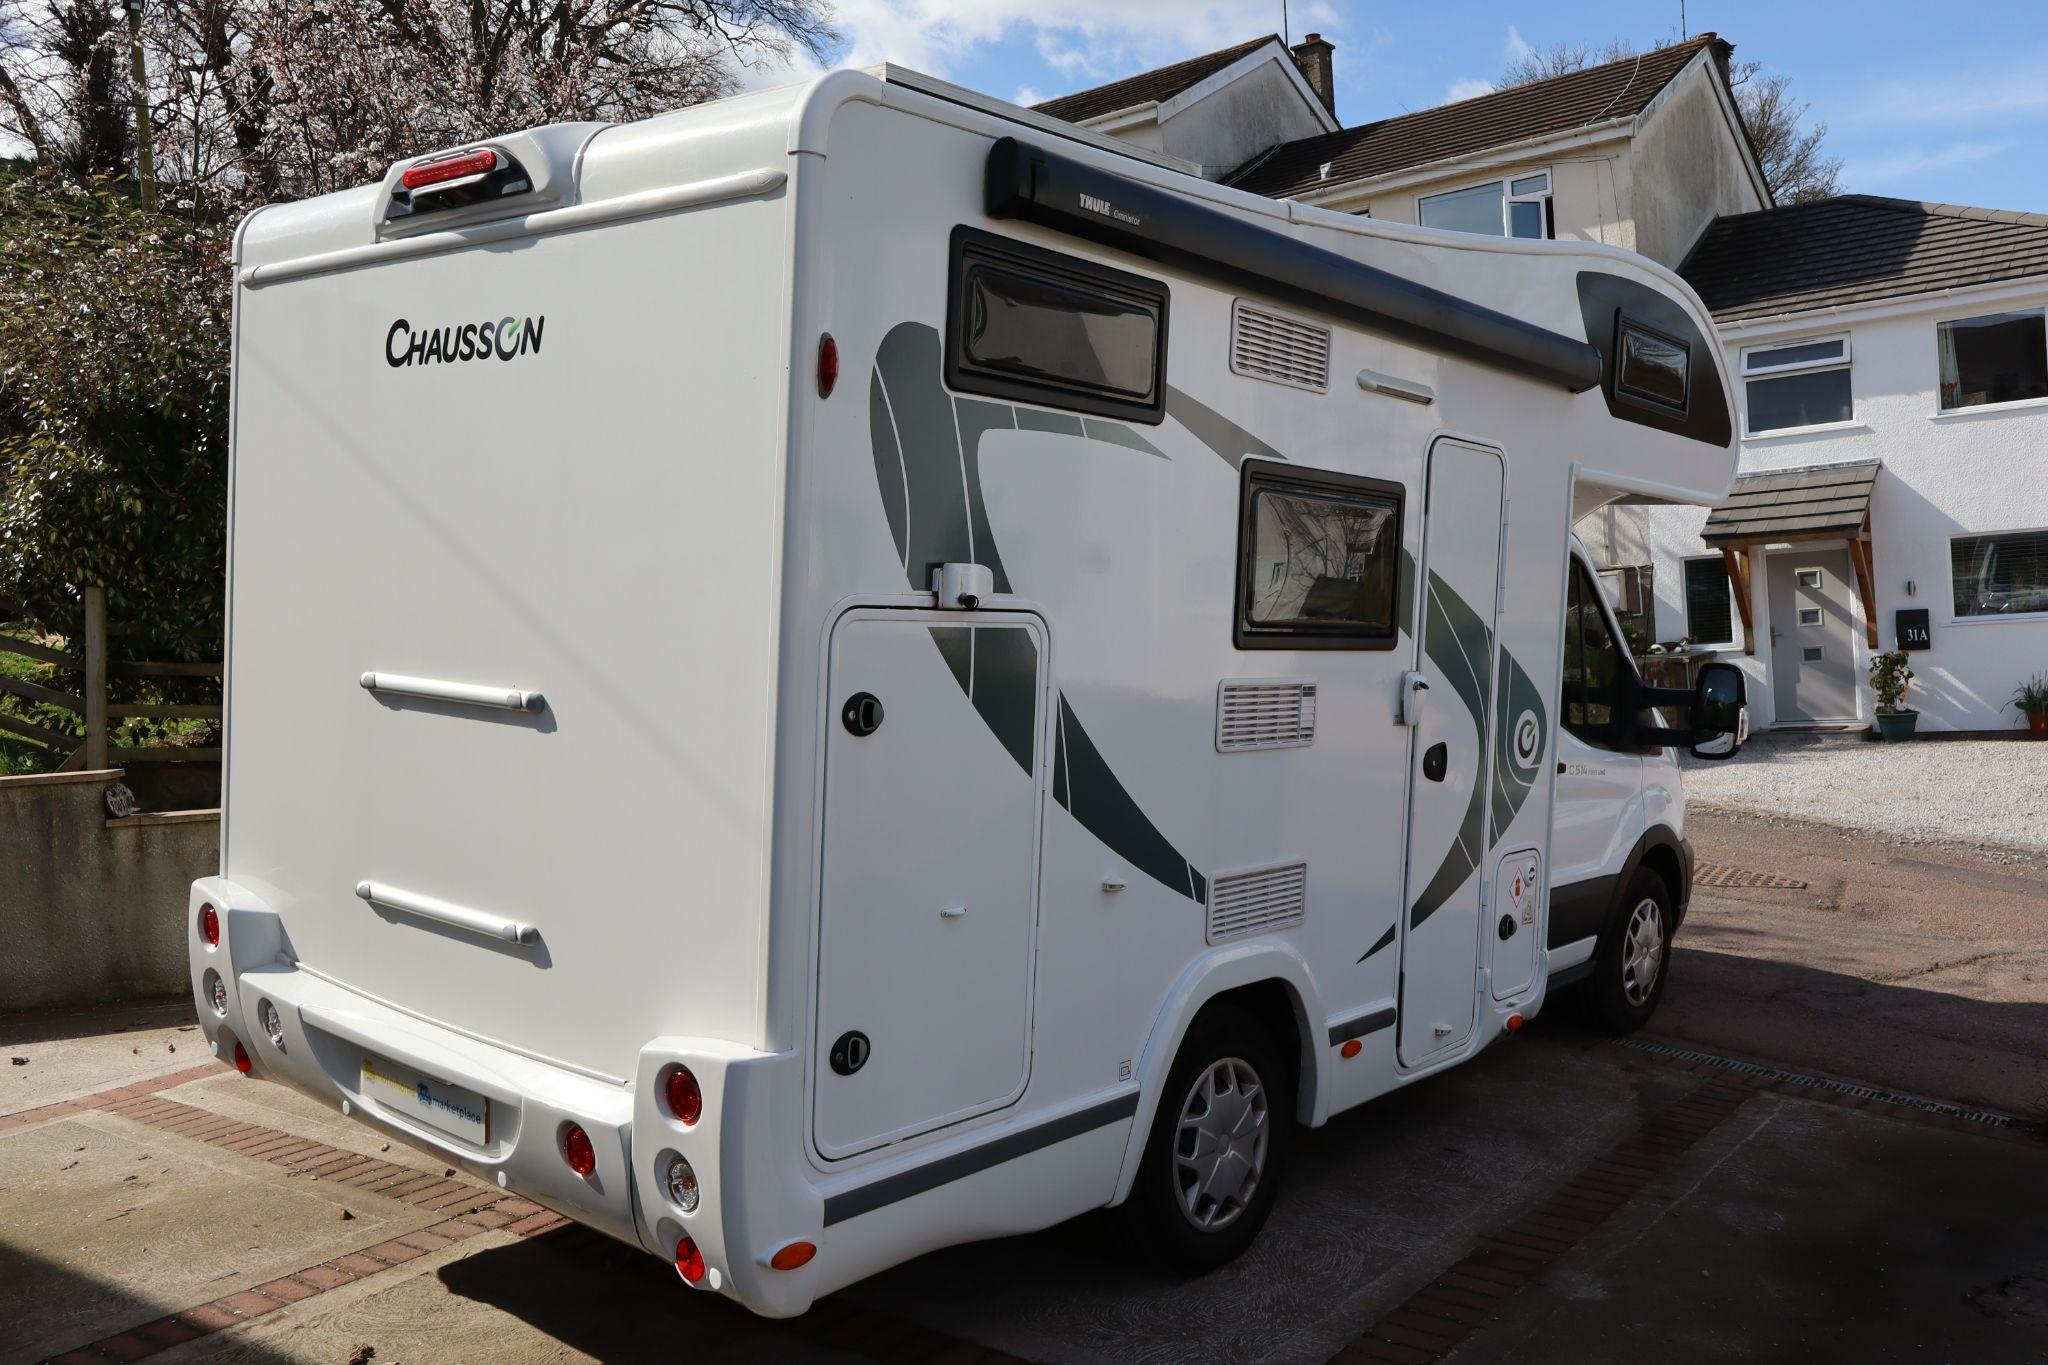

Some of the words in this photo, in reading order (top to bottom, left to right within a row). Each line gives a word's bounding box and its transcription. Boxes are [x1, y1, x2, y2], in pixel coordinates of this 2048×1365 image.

[1080, 192, 1110, 216] THULE
[1113, 209, 1140, 226] Omnistor
[386, 315, 545, 368] CHAUSSON
[1907, 628, 1928, 642] 31A
[432, 1097, 481, 1125] marketplace
